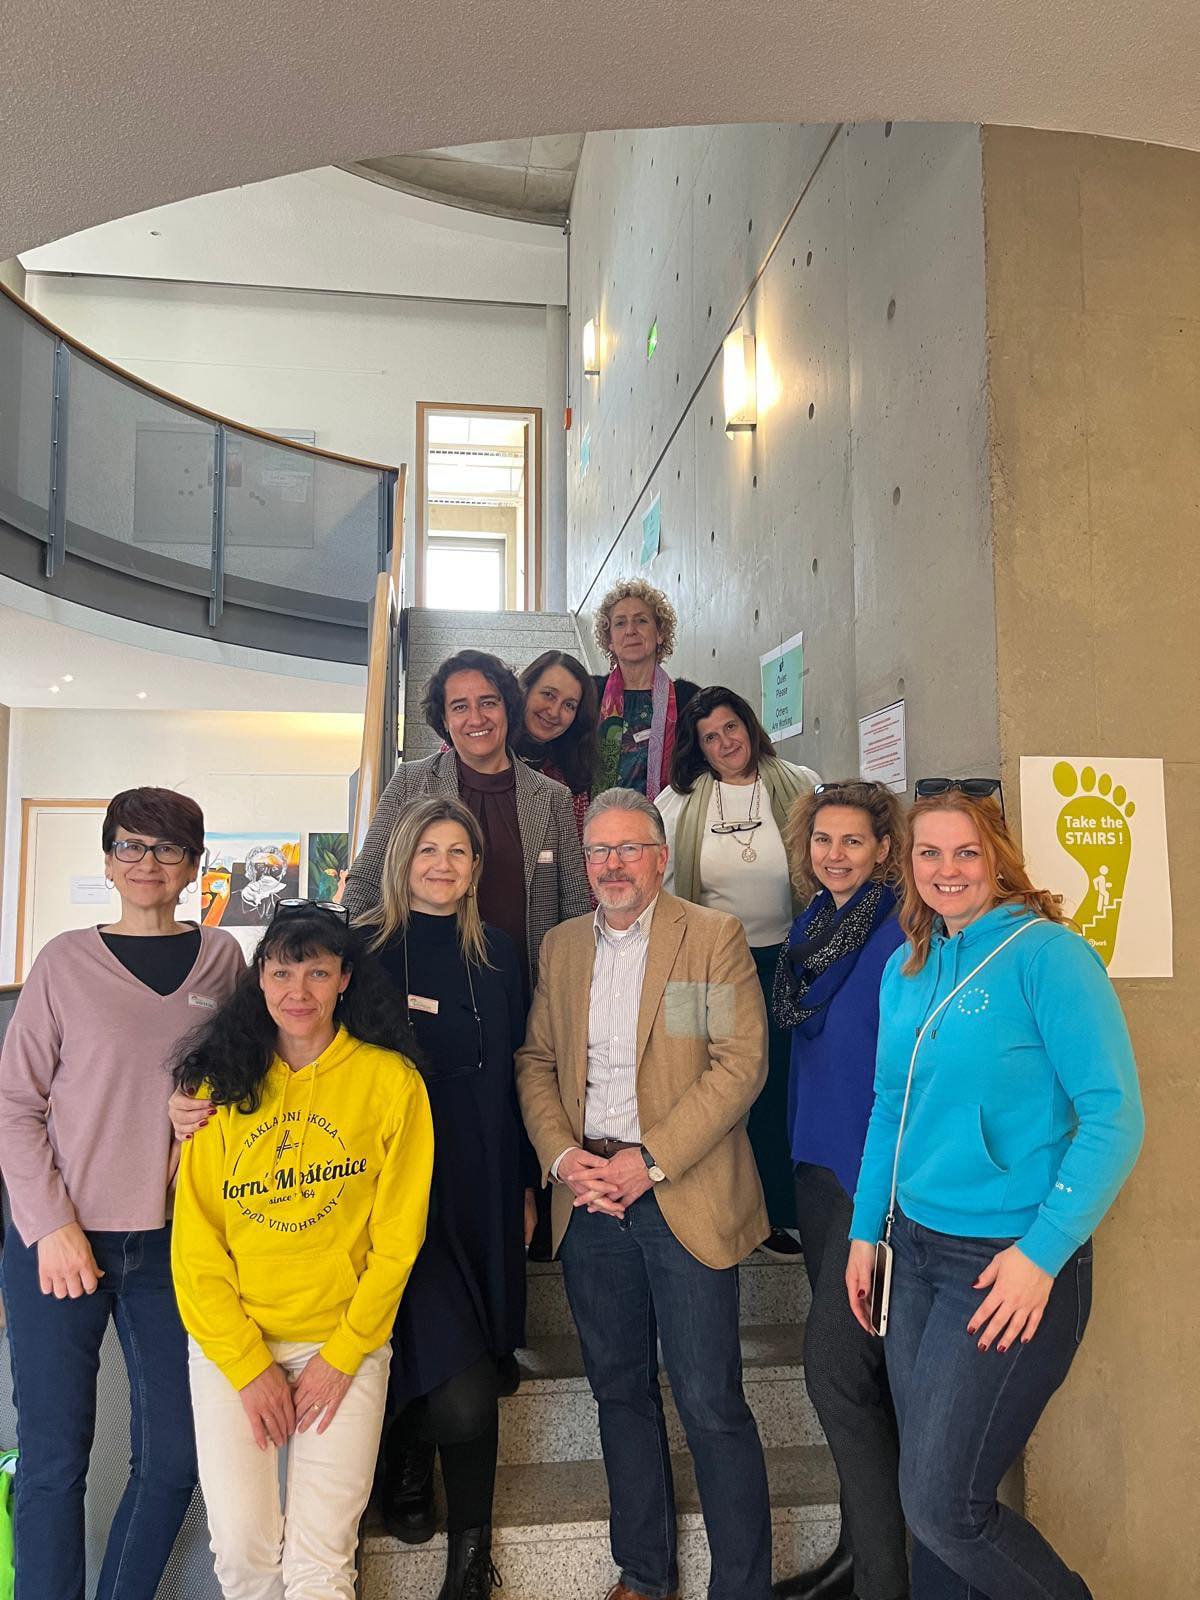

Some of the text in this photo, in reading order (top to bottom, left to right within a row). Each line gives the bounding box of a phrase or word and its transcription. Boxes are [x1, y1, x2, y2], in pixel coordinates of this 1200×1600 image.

[1064, 815, 1123, 829] Take the
[268, 1189, 316, 1205] since 64
[242, 1198, 338, 1233] POD VINOHRADY
